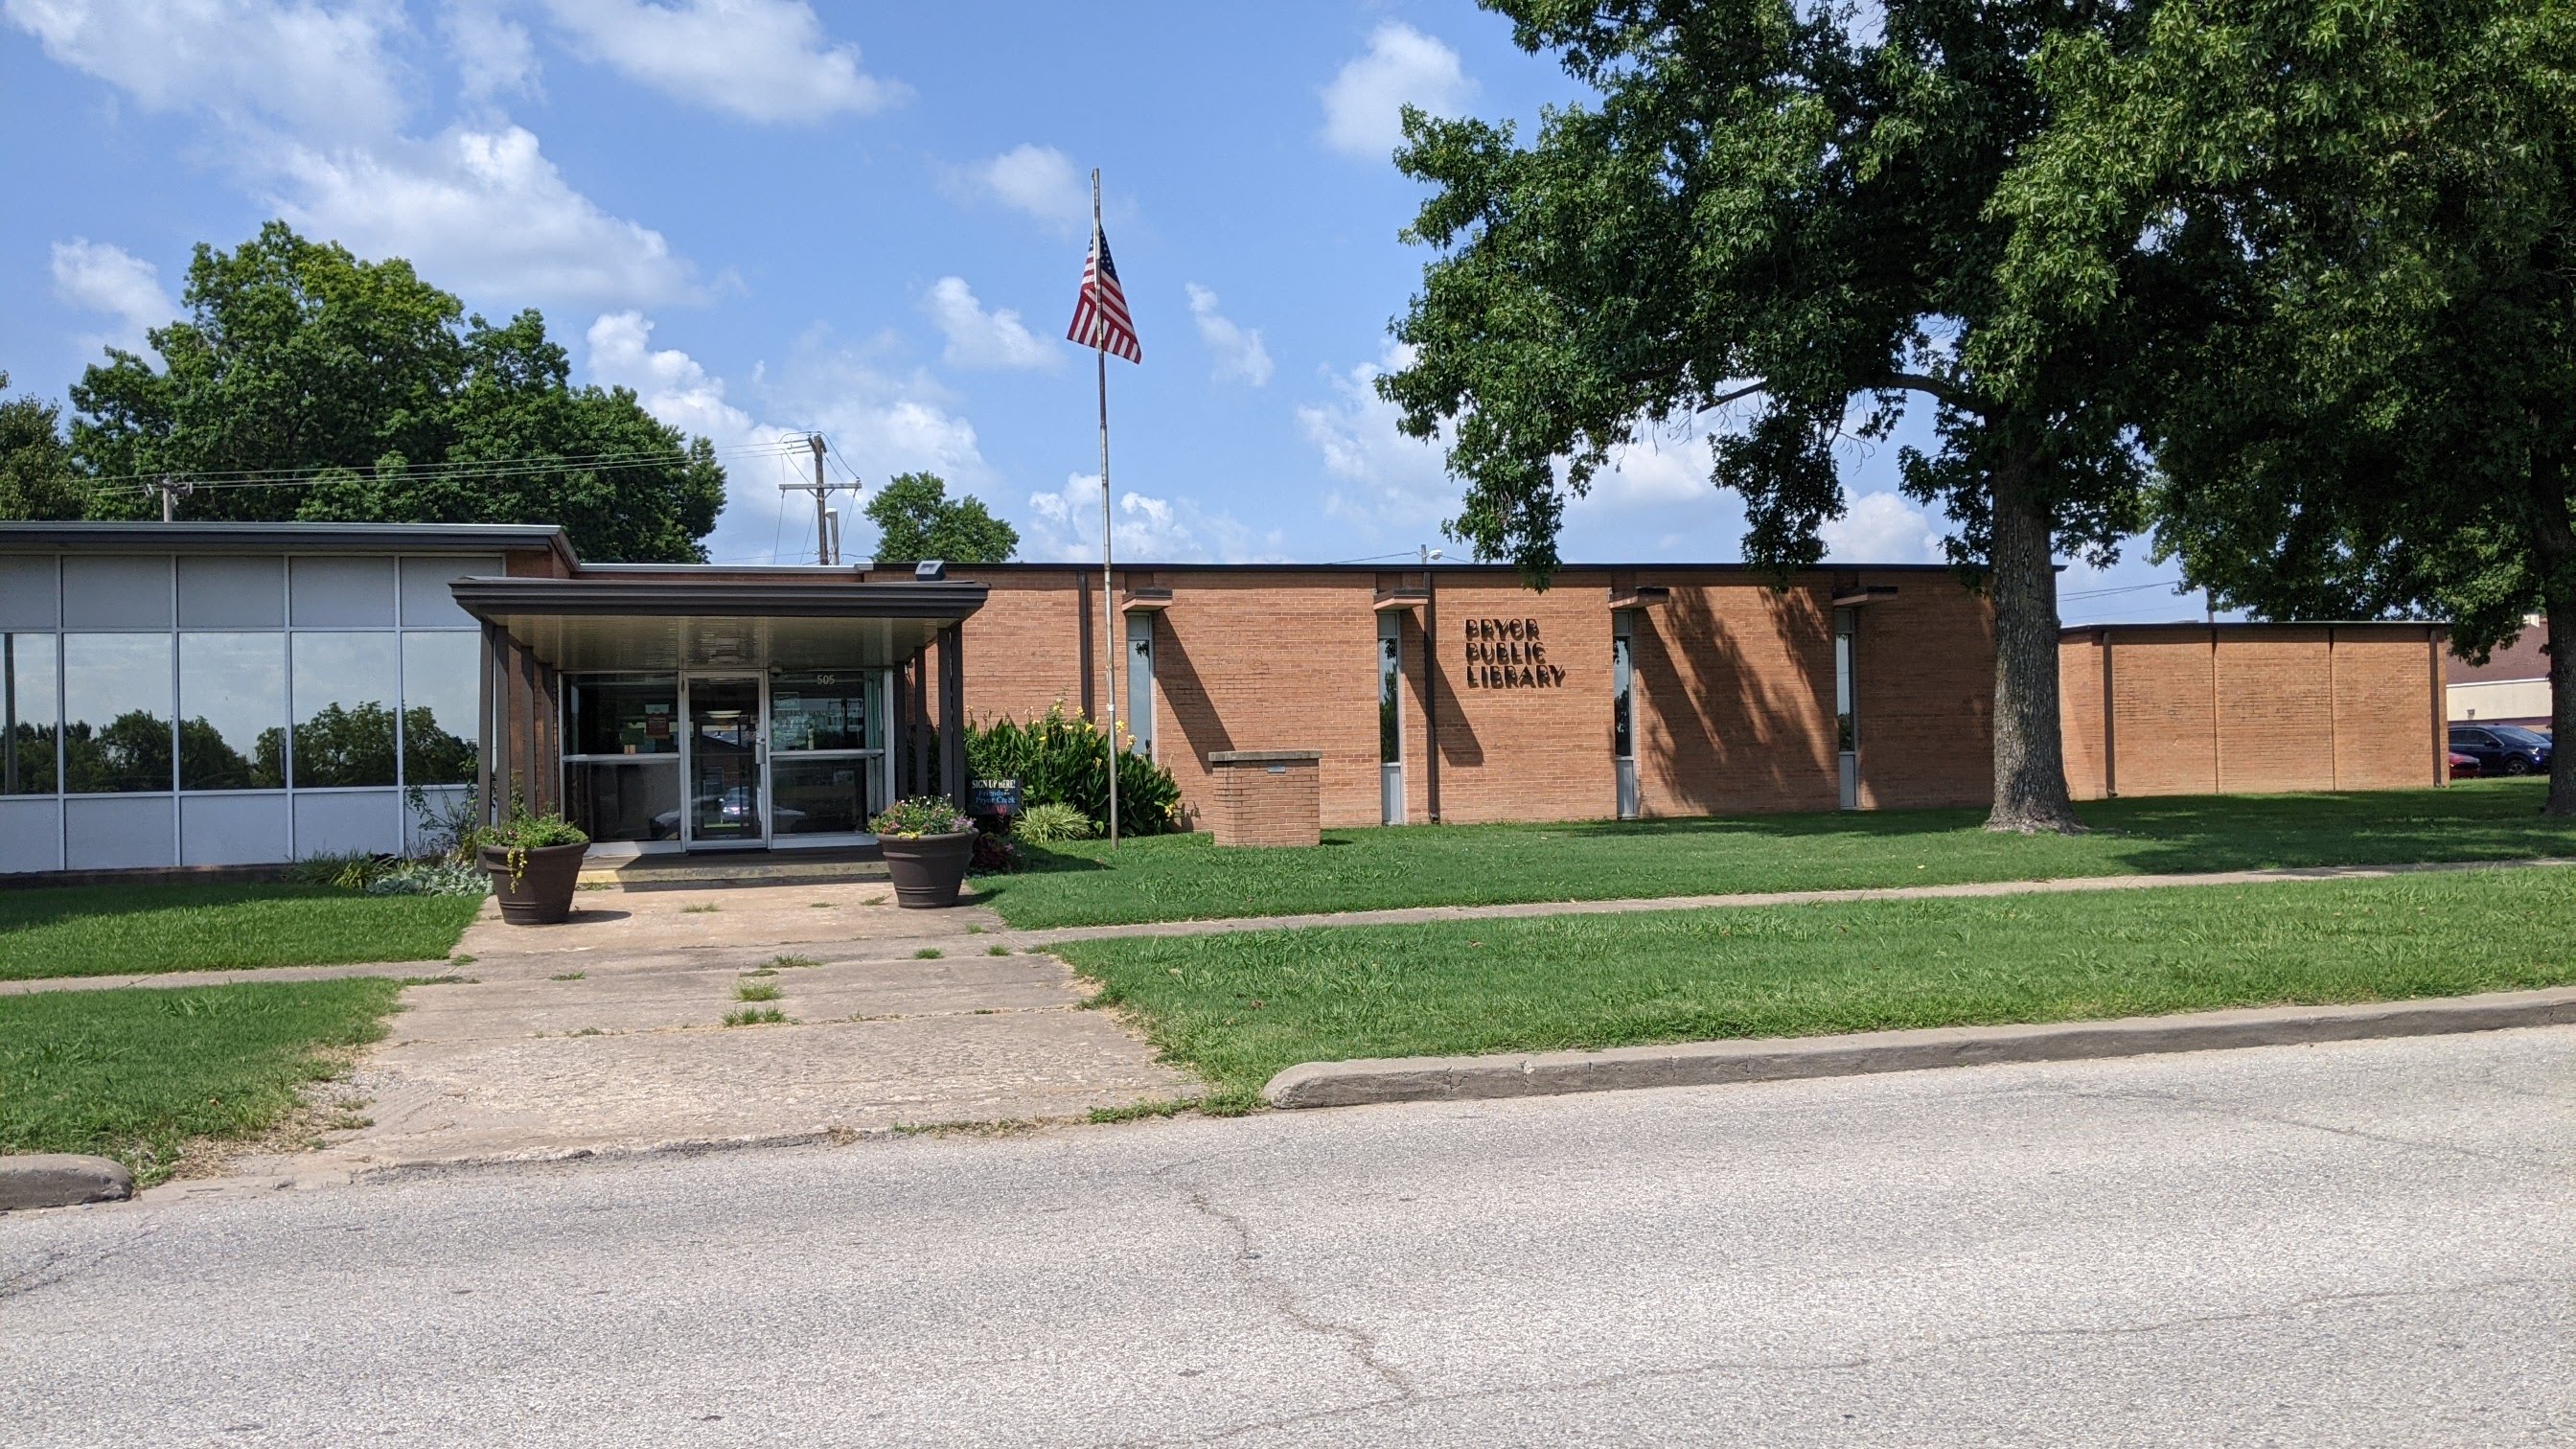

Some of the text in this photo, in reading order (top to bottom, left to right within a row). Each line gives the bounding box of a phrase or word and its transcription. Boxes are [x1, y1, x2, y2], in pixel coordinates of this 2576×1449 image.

[1465, 619, 1540, 641] PRYOR
[1465, 642, 1546, 665] PUBLIC
[816, 675, 835, 685] 505
[1467, 664, 1566, 689] LIBRARY
[972, 779, 1016, 789] SIGN UP HERE!
